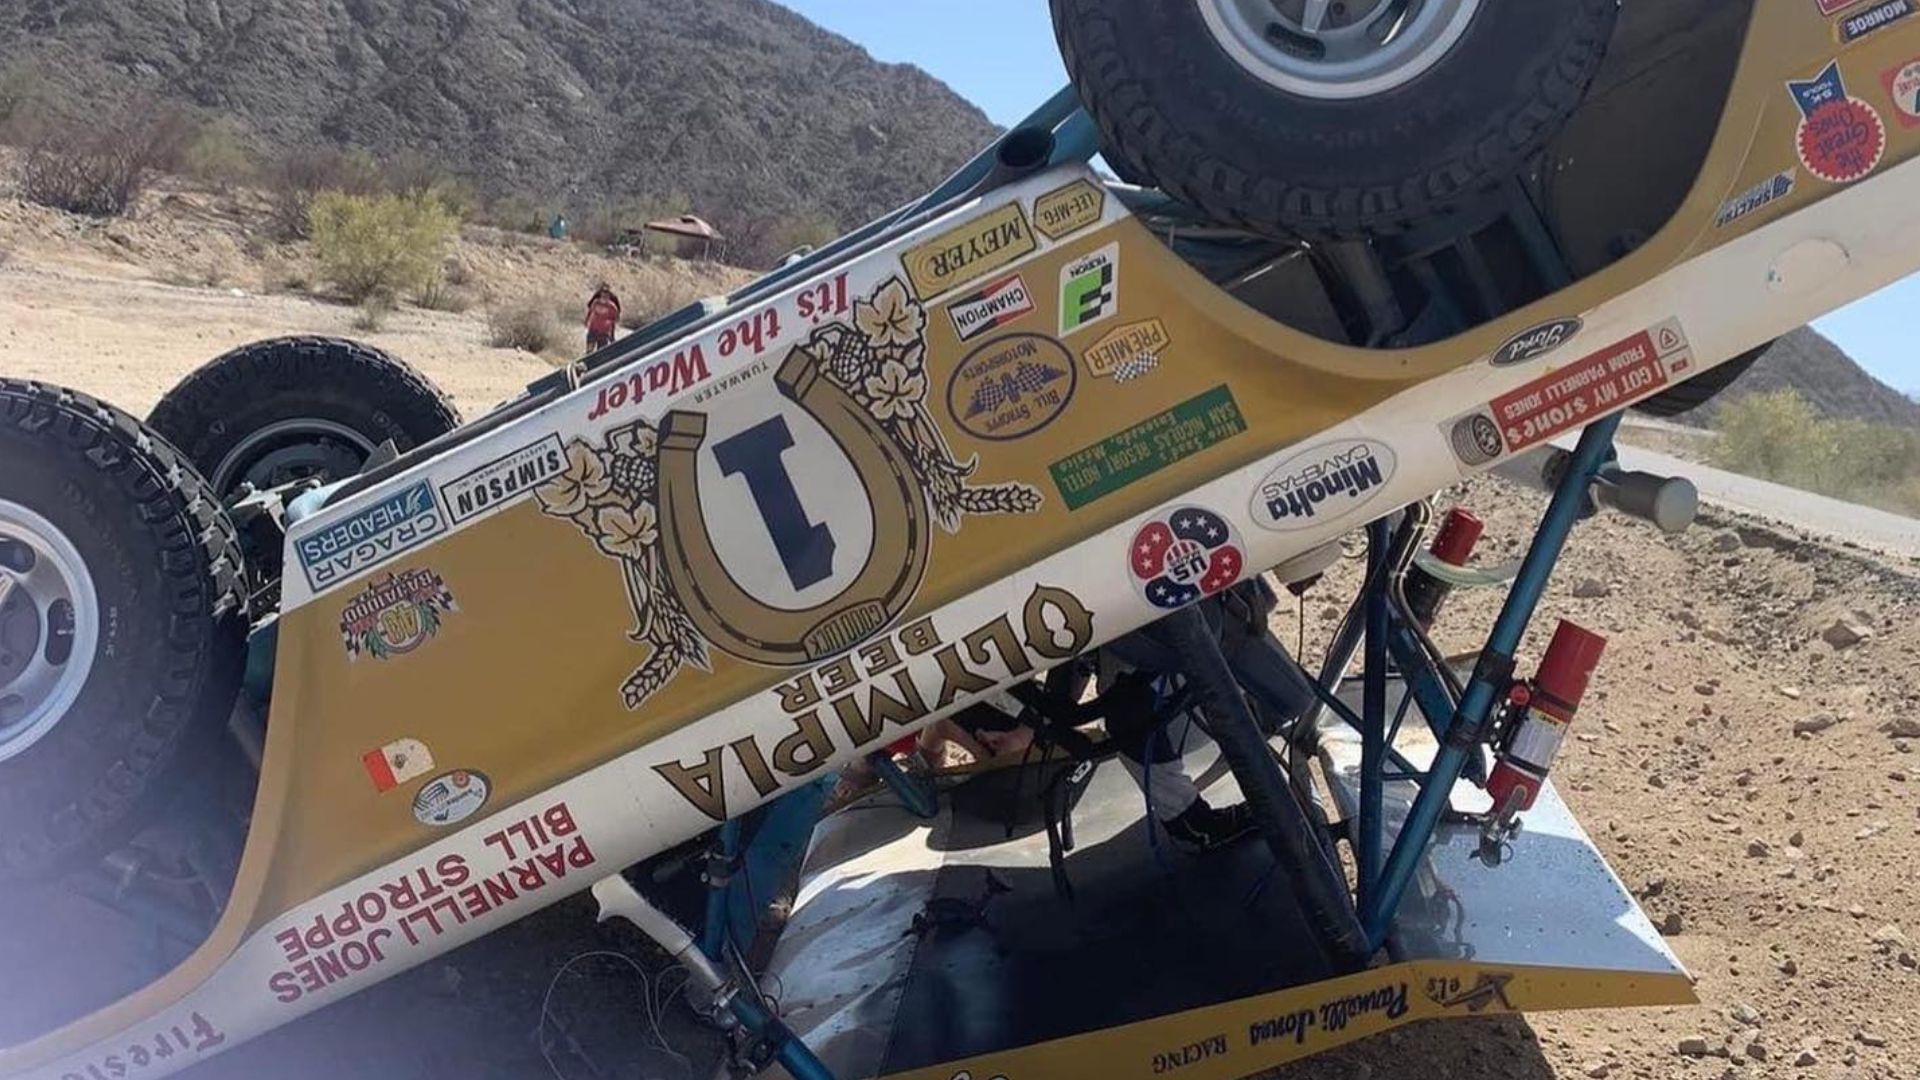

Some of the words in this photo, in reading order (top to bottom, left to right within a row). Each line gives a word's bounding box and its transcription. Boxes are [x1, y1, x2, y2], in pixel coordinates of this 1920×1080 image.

[1846, 0, 1907, 36] MONROE
[1815, 123, 1868, 159] Great
[1836, 150, 1863, 172] the
[929, 217, 1022, 279] MEYER
[796, 271, 849, 324] It's
[956, 287, 1024, 329] CHAMPION
[716, 307, 781, 357] the
[1088, 322, 1162, 371] PREMIER
[1507, 323, 1564, 360] Ford
[1606, 344, 1647, 371] FROM
[1619, 366, 1651, 390] GOT
[1652, 360, 1663, 378] I
[587, 343, 711, 421] Water
[693, 360, 769, 404] TUMWATER
[1544, 361, 1606, 401] PARNELLI
[1592, 379, 1618, 407] MY
[1207, 401, 1237, 422] SAN
[1503, 391, 1542, 420] JONES
[1152, 415, 1205, 450] NICOLAS
[1060, 465, 1102, 493] HOTEL
[1106, 441, 1152, 475] RESORT
[1261, 443, 1371, 500] CAMERAS
[457, 449, 561, 515] SIMPSON
[711, 413, 836, 593] 1
[1265, 455, 1383, 522] Minolta
[303, 499, 403, 564] HEADERS
[312, 513, 438, 582] CRAGAR
[773, 615, 945, 716] BEER
[650, 583, 1095, 822] OLYMPIA
[483, 802, 577, 860] BILL
[274, 853, 471, 963] STROPPE
[397, 835, 597, 946] PARNELLI
[268, 928, 392, 1004] JONES
[1248, 1009, 1315, 1047] Jones
[1319, 983, 1409, 1032] Parnelli
[1150, 1034, 1227, 1074] RACING
